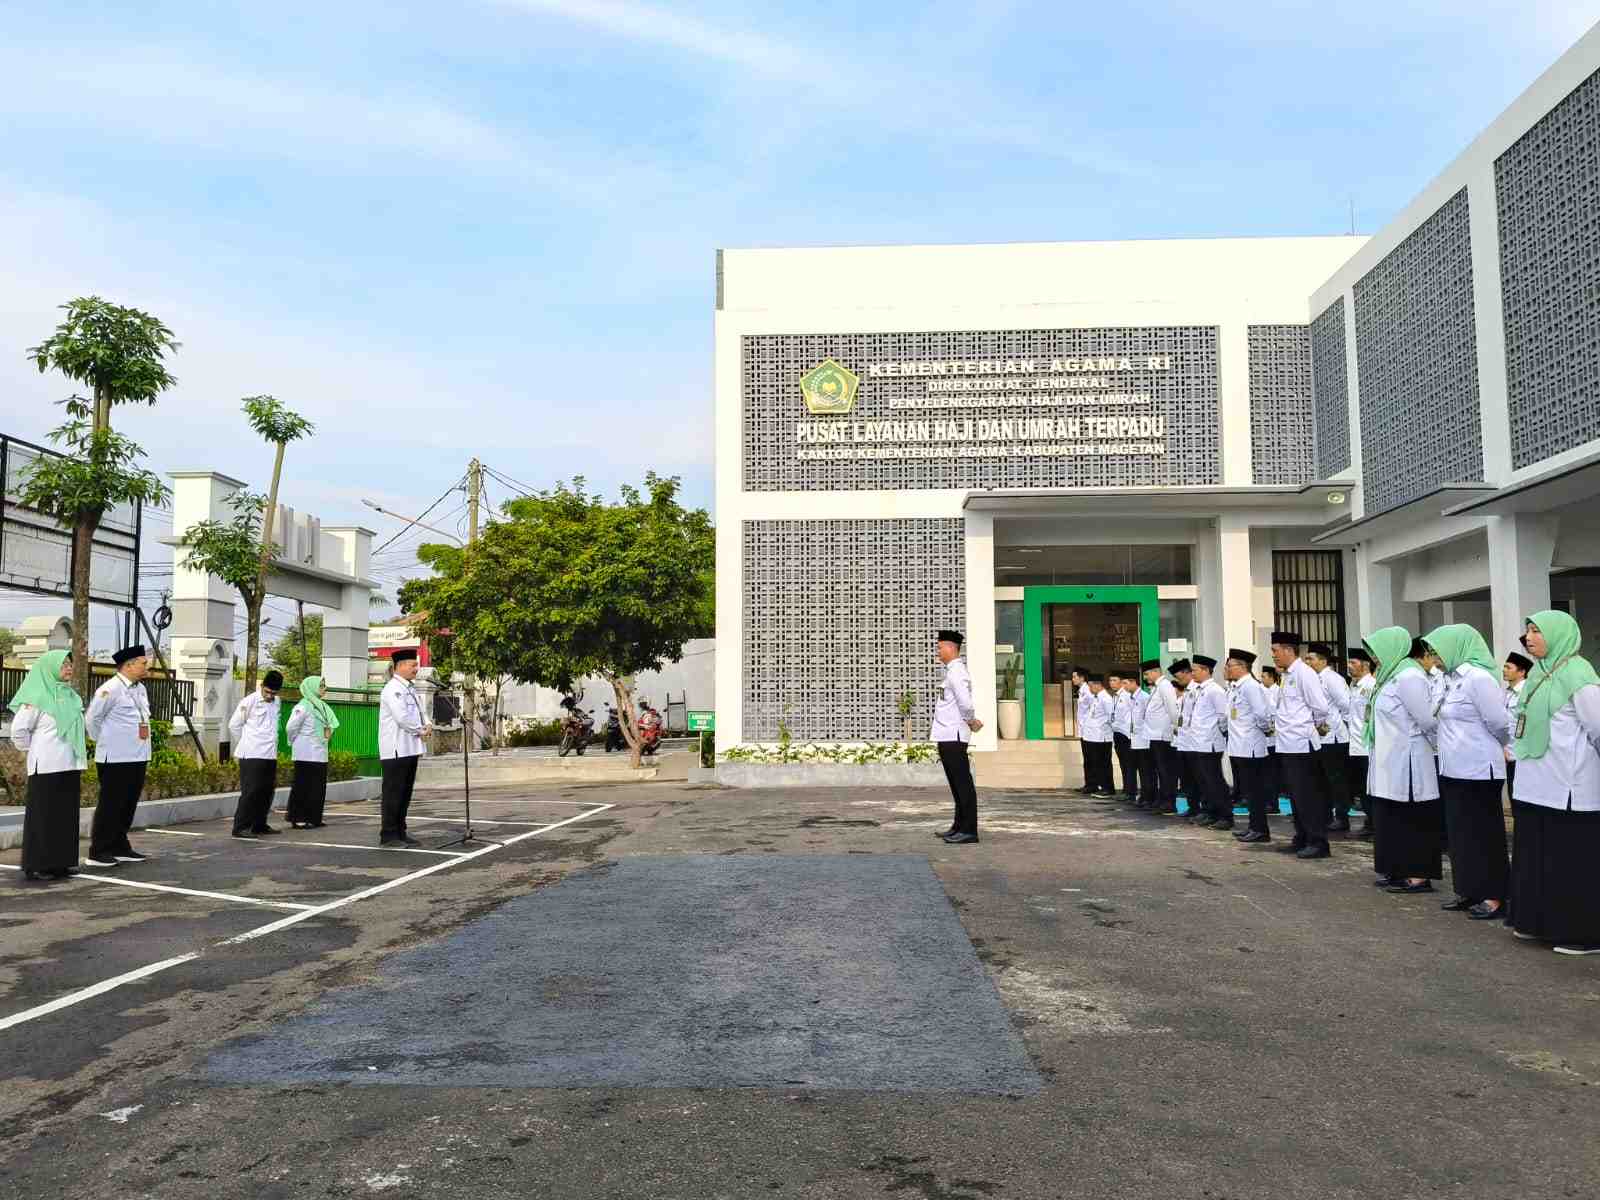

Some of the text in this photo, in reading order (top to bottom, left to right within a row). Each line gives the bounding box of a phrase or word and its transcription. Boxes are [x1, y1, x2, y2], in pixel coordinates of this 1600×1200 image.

[870, 356, 1170, 377] KEMENTERIAN AGAMA RI
[928, 377, 1109, 391] DIREKTORAT JENDERAL
[889, 393, 1150, 408] PENYELENGGARAAN HAJI DAN UMRAH
[797, 416, 1164, 443] PUSAT LAYANAN HAJI DAN UMRAH TERPADU
[797, 443, 1165, 460] KANTOR KEMENTERIAN AGAMA KABUPATEN MAGETAN
